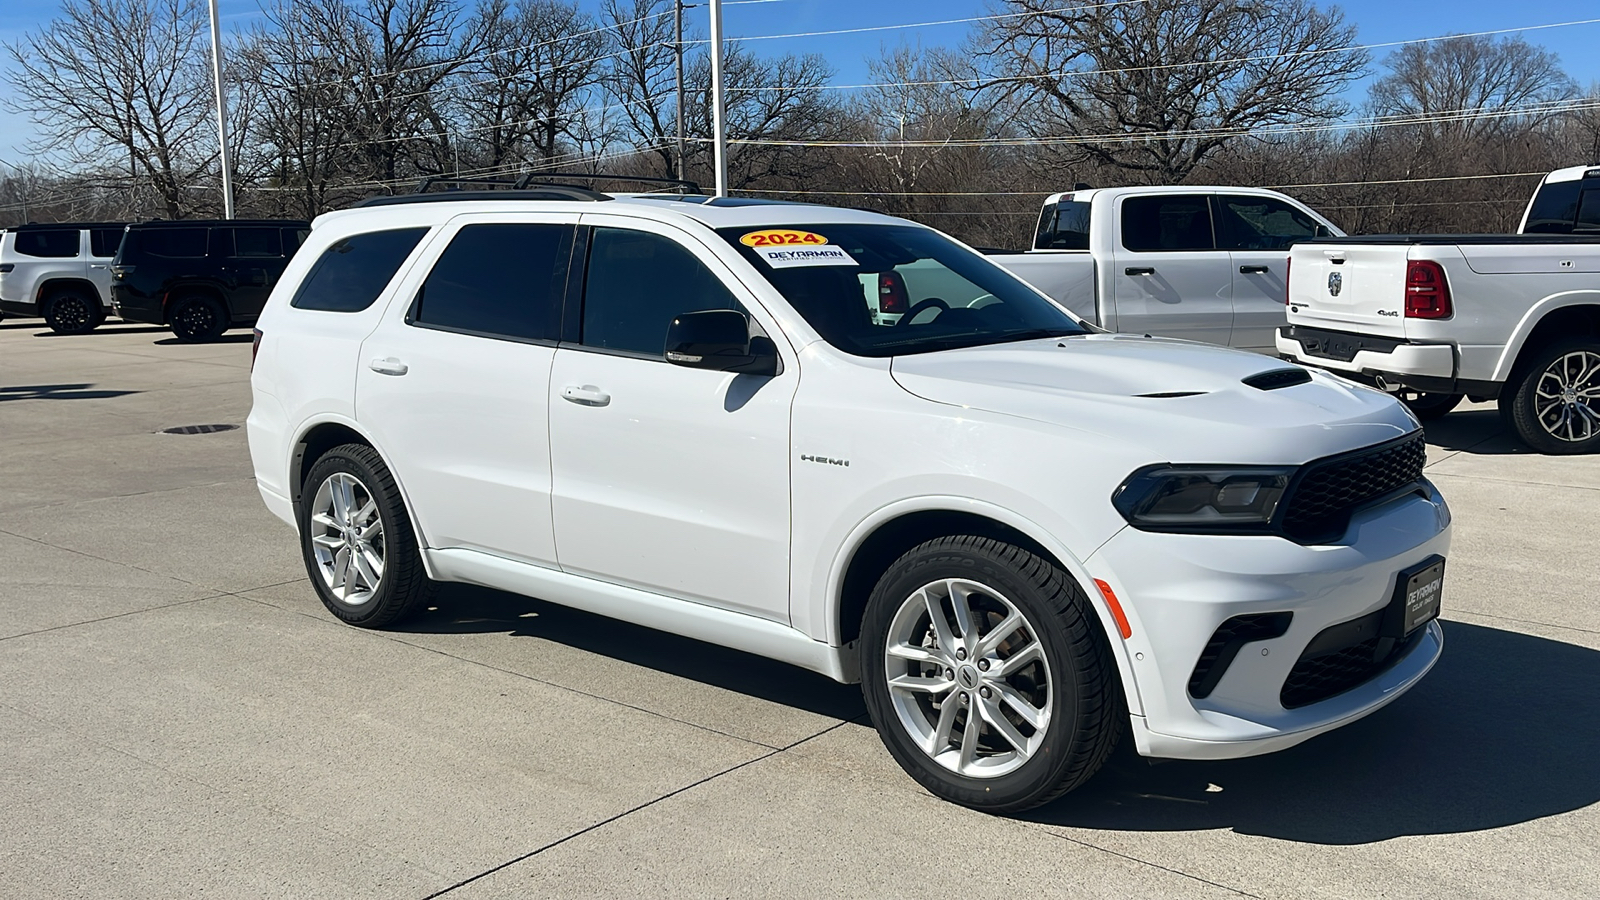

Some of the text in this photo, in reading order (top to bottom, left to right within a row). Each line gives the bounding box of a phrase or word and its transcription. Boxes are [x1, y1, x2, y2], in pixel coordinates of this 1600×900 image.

[751, 233, 820, 246] 2024
[768, 250, 844, 259] DEYARMAN
[801, 454, 850, 467] HEMI
[1407, 577, 1442, 606] DEYARMAN
